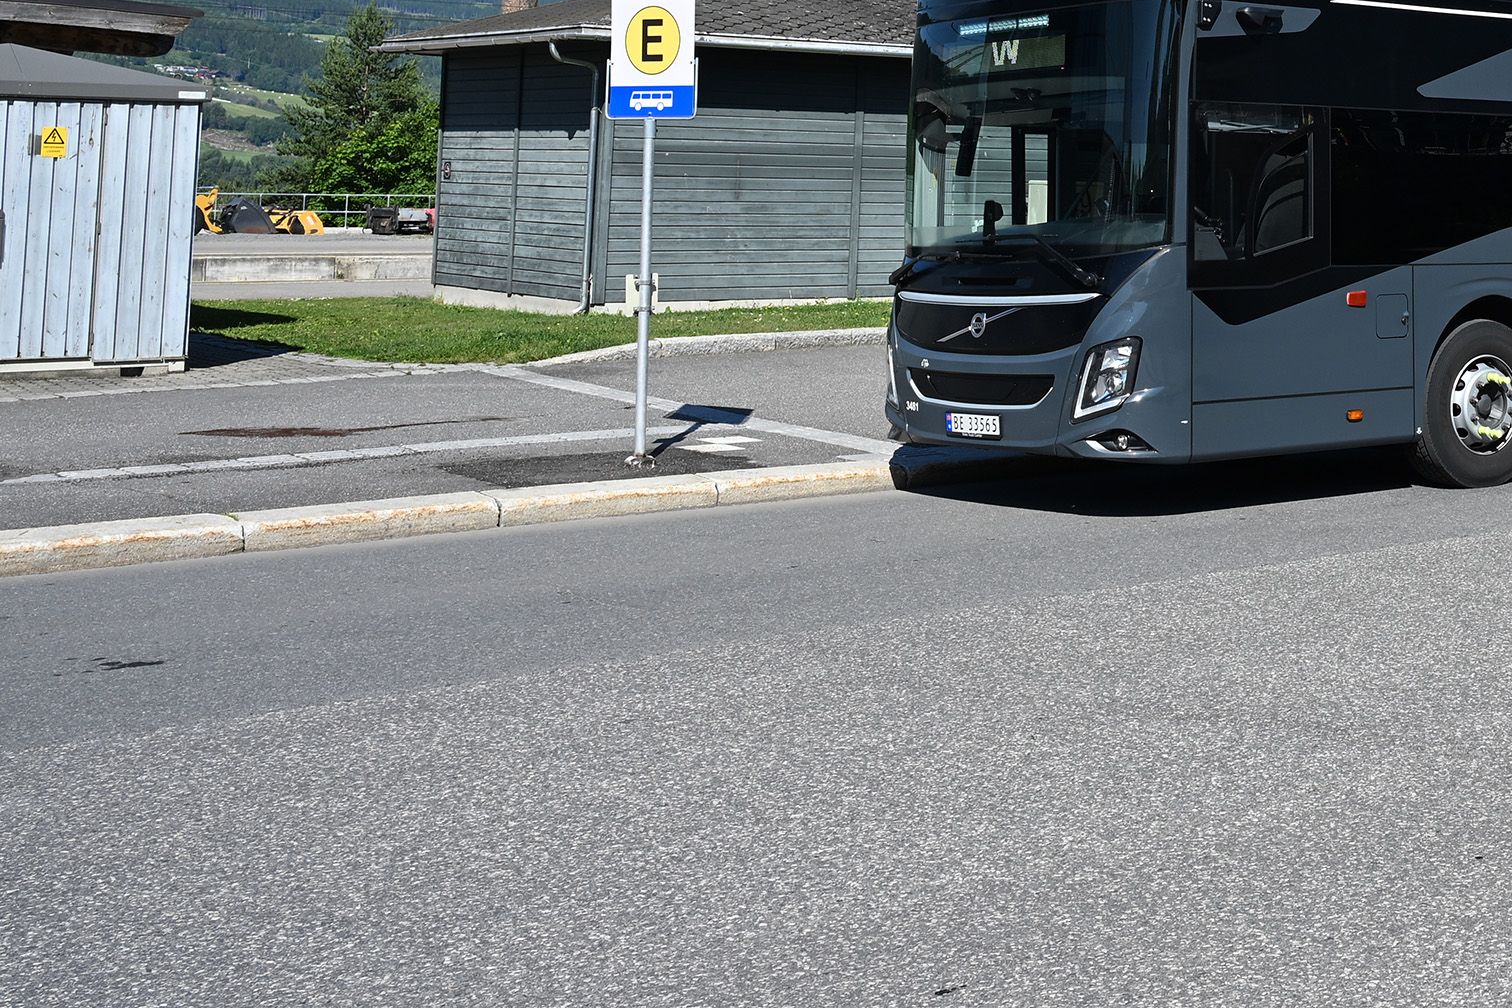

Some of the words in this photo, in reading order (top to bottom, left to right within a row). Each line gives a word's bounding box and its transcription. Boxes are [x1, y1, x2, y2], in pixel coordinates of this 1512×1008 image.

[641, 18, 664, 62] E
[953, 415, 964, 430] BE
[968, 416, 998, 433] 33565
